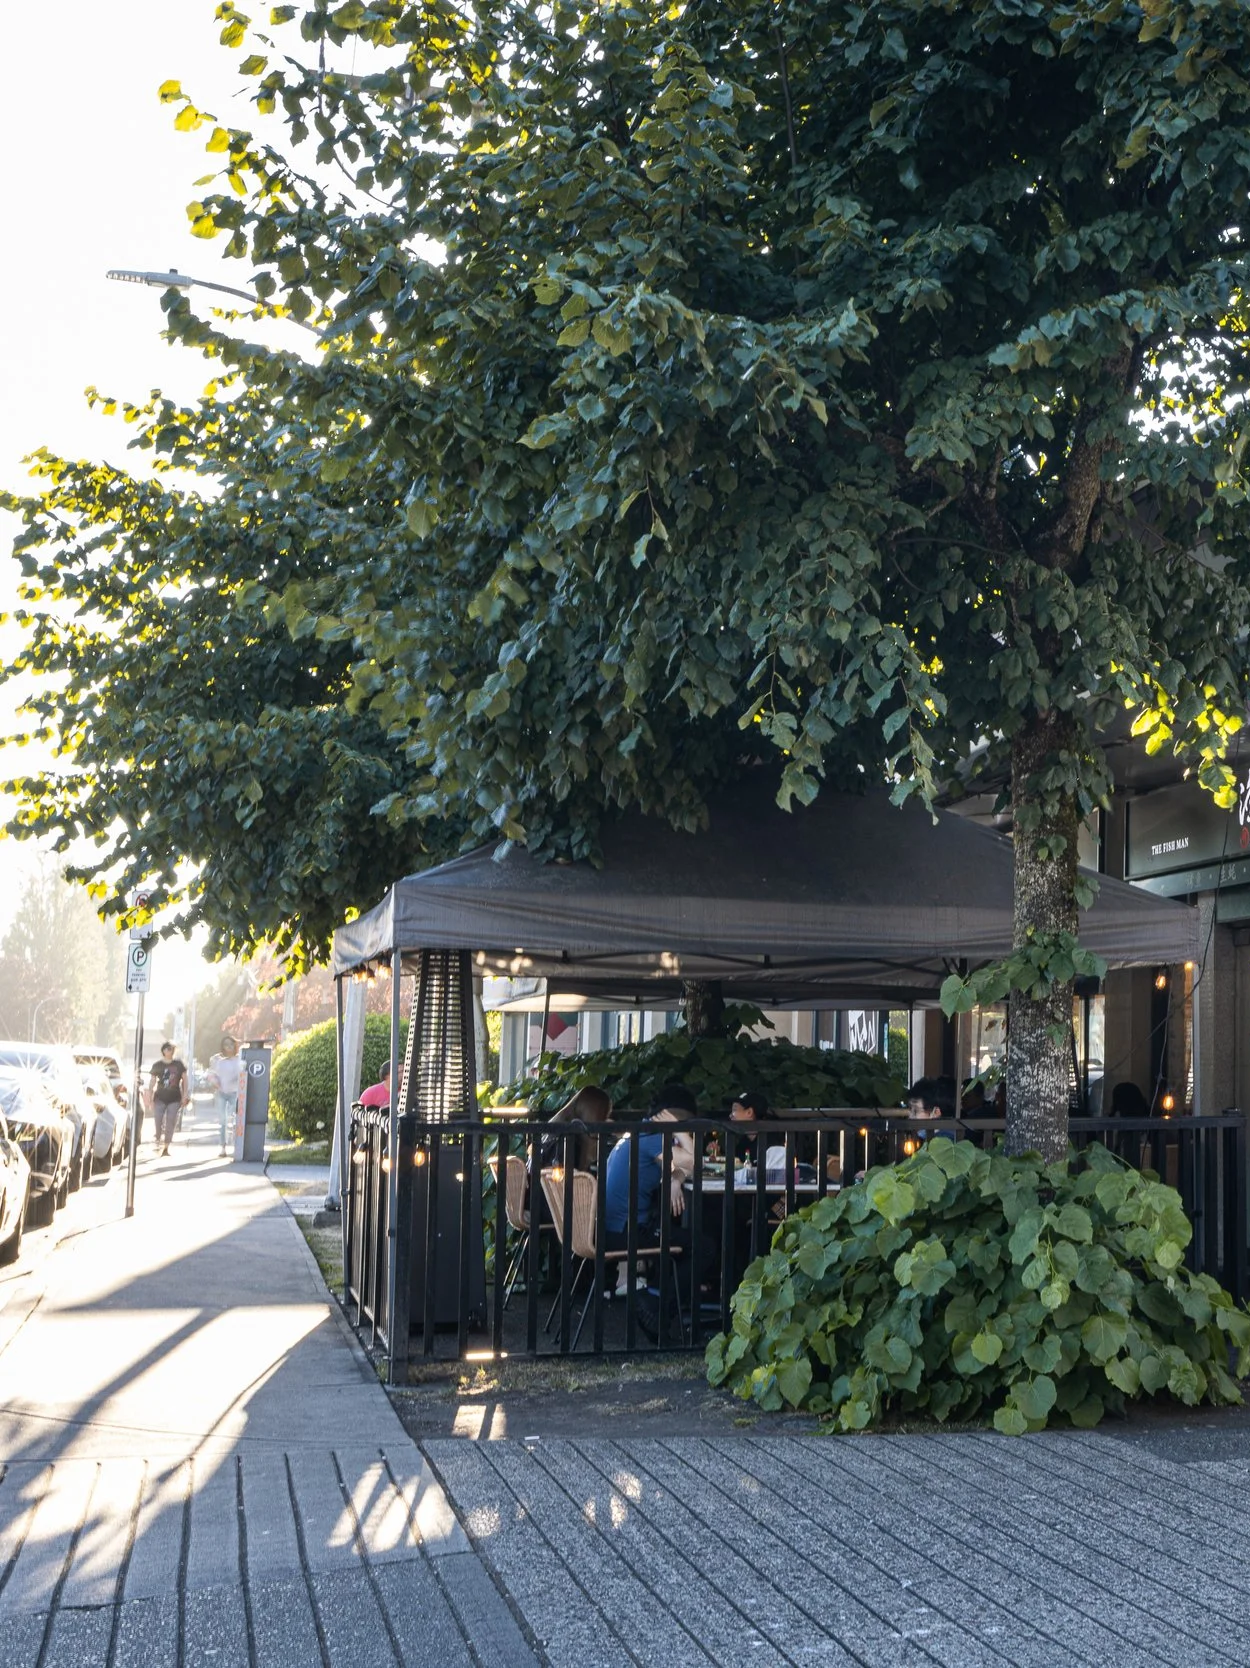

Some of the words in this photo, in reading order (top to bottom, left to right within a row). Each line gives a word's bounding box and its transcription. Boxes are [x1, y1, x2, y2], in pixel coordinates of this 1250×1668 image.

[1151, 844, 1162, 856] THE
[1163, 840, 1176, 852] FISH
[1176, 837, 1189, 849] MAN
